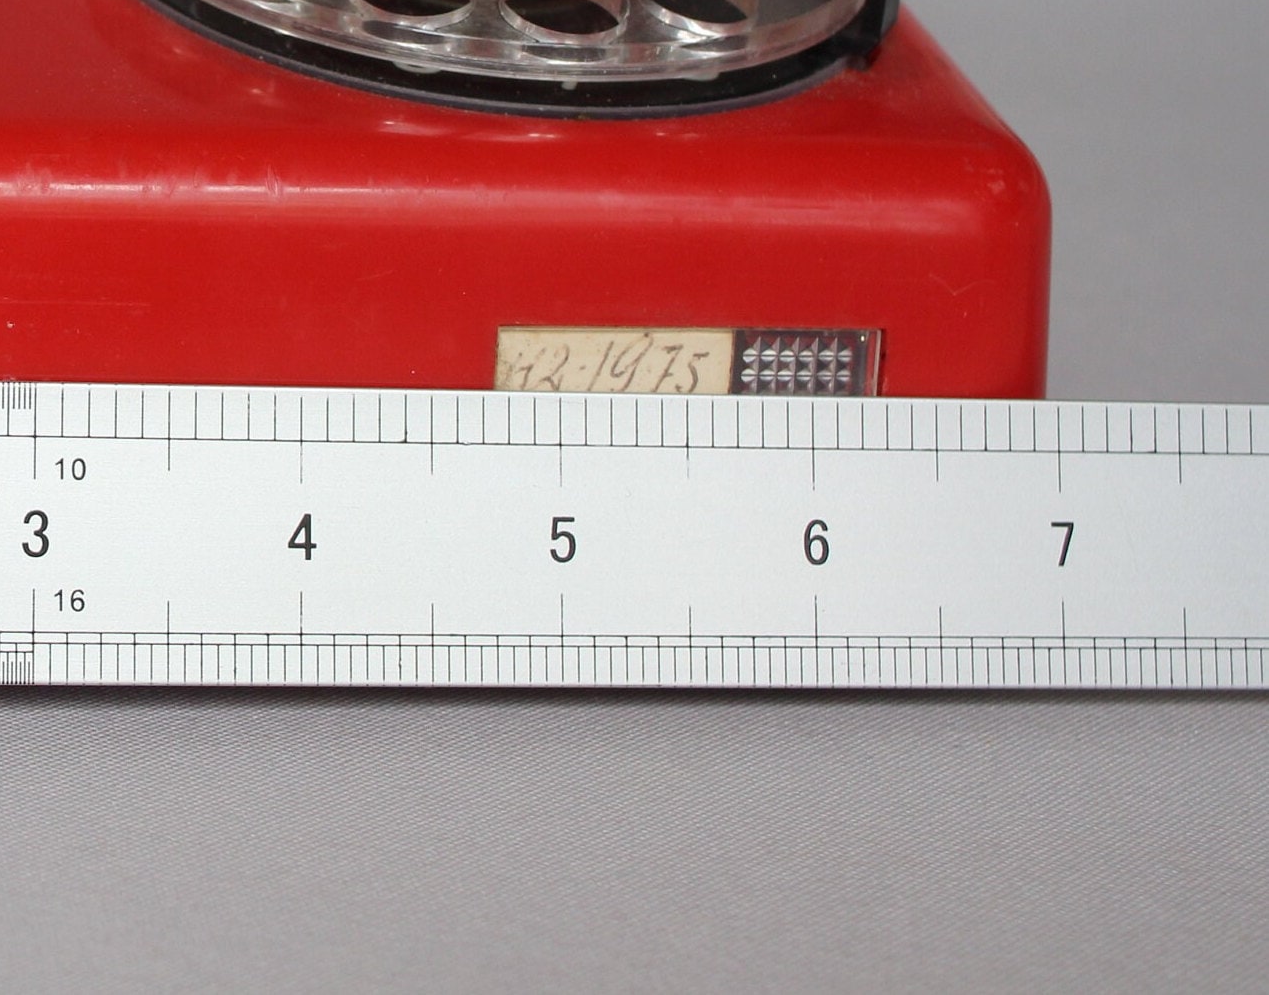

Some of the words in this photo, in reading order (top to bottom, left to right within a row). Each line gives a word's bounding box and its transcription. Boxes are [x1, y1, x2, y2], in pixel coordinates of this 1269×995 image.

[55, 457, 87, 481] 10
[21, 509, 50, 558] 3
[287, 513, 318, 561] 4
[549, 516, 577, 564] 5
[803, 519, 830, 566] 6
[1050, 521, 1075, 567] 7
[54, 589, 86, 613] 16
